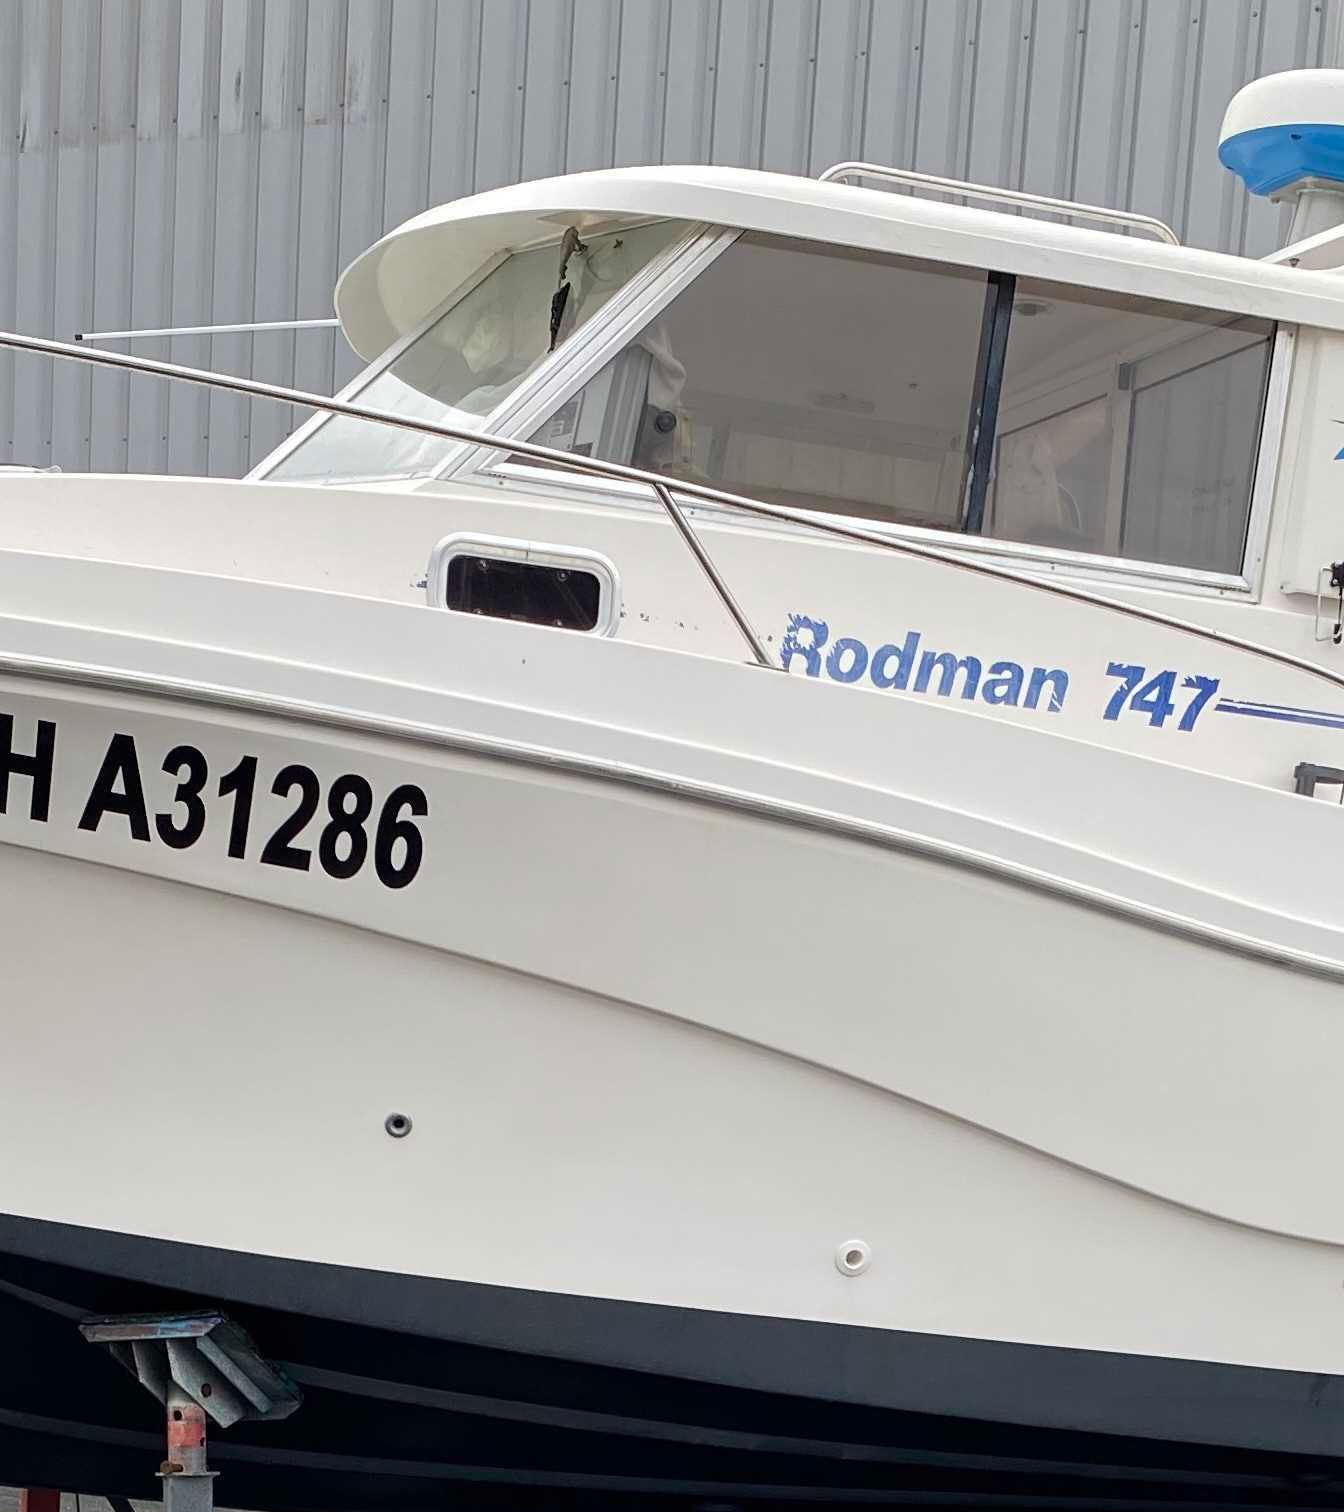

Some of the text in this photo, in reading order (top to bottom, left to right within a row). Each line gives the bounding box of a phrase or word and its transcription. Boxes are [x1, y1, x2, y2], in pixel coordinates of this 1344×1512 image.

[780, 613, 1220, 732] Rodman 747
[77, 732, 429, 889] A31286
